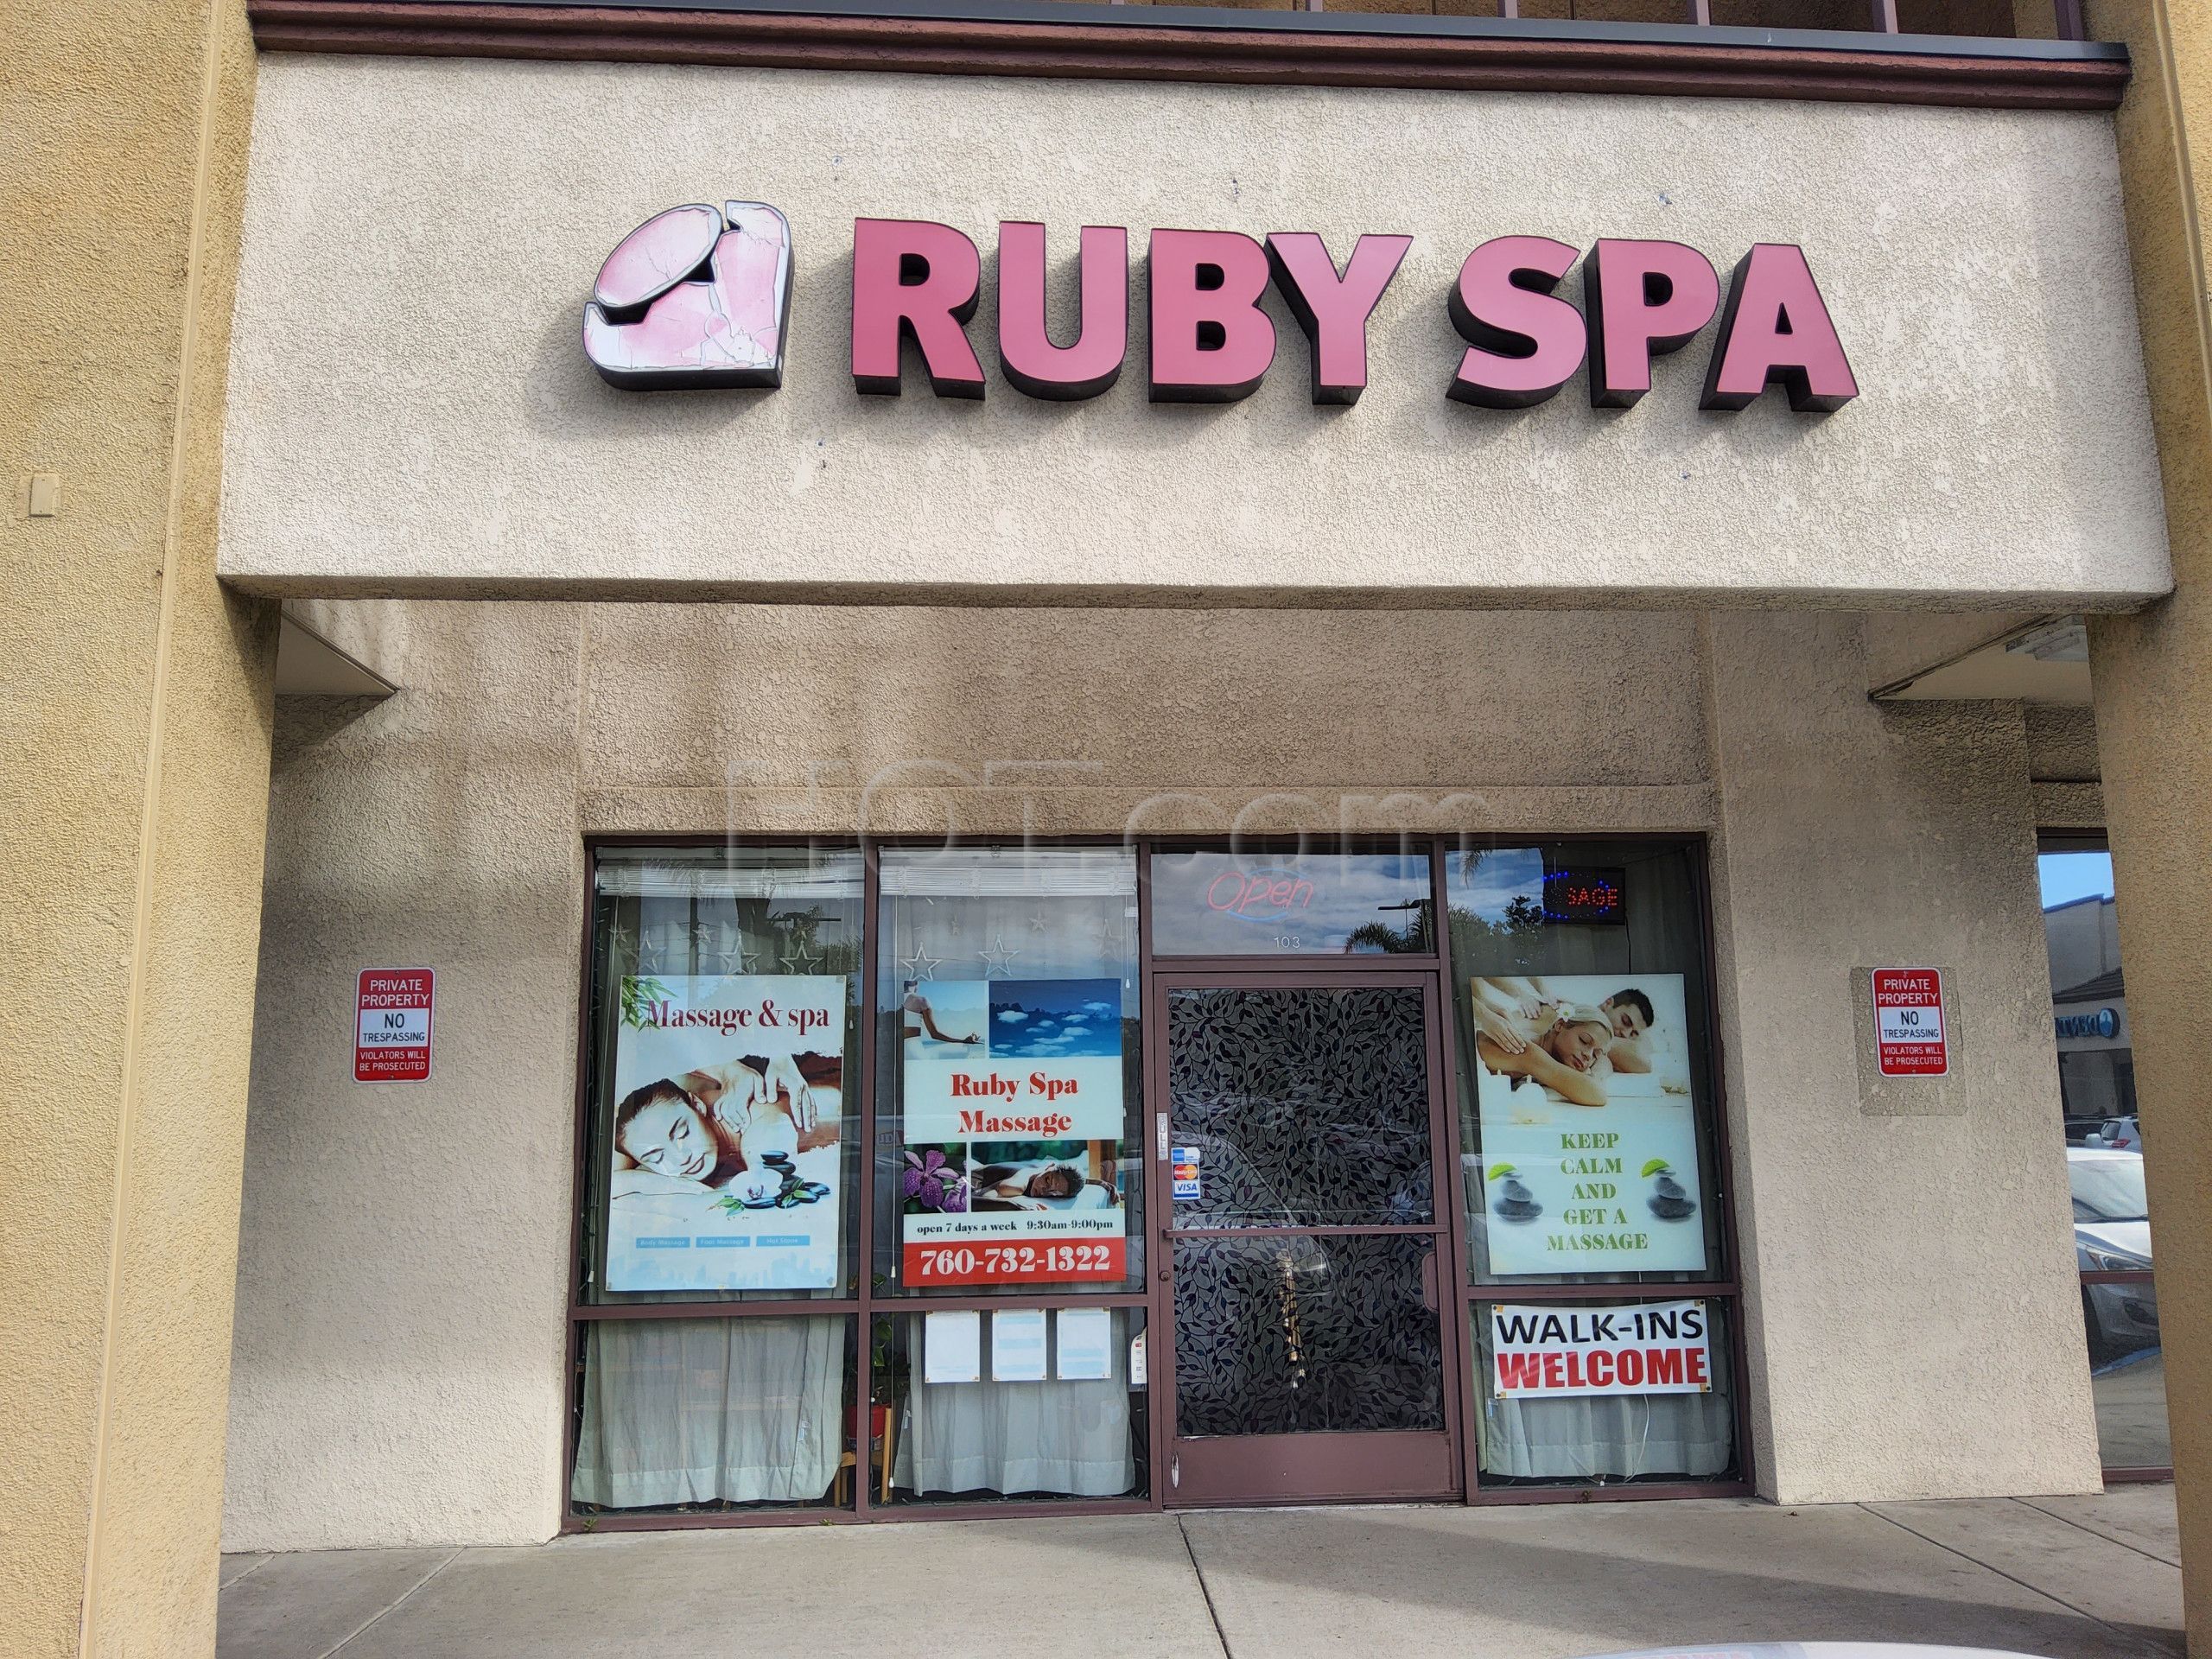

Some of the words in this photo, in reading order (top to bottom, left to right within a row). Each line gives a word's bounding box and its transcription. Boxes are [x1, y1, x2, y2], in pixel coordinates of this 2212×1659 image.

[851, 218, 1413, 410] RUBY
[1446, 233, 1860, 413] SPA
[1206, 871, 1314, 913] Open
[1274, 936, 1300, 949] 103
[370, 979, 423, 991] PRIVATE
[1884, 979, 1931, 990] PRIVATE
[361, 994, 430, 1007] PROPERTY
[1878, 993, 1938, 1004] PROPERTY
[384, 1013, 405, 1028] NO
[645, 1000, 753, 1037] Massage
[759, 999, 784, 1027] &
[788, 1008, 830, 1036] spa
[1901, 1011, 1919, 1026] NO
[363, 1032, 425, 1043] TRESPASSING
[1883, 1029, 1939, 1039] TRESPASSING
[360, 1051, 404, 1060] VIOLATORS
[407, 1051, 426, 1059] WILL
[1884, 1046, 1923, 1055] VIOLATORS
[359, 1062, 370, 1071] BE
[372, 1061, 426, 1071] PROSECUTED
[1885, 1057, 1894, 1065] BE
[1896, 1057, 1943, 1065] PROSECUTED
[950, 1072, 1020, 1103] Ruby
[1029, 1071, 1079, 1101] Spa
[957, 1110, 1072, 1138] Massage
[1560, 1132, 1619, 1149] KEEP
[1560, 1157, 1623, 1174] CALM
[1177, 1183, 1198, 1192] VISA
[1571, 1183, 1617, 1200] AND
[1563, 1209, 1607, 1225] GET
[1613, 1208, 1628, 1224] A
[917, 1223, 943, 1234] open
[945, 1223, 951, 1232] 7
[955, 1222, 978, 1234] days
[990, 1221, 1018, 1231] week
[1547, 1233, 1648, 1251] MASSAGE
[920, 1245, 1110, 1276] 760-732-1322
[1496, 1309, 1704, 1344] WALK-INS
[1497, 1347, 1708, 1389] WELCOME
